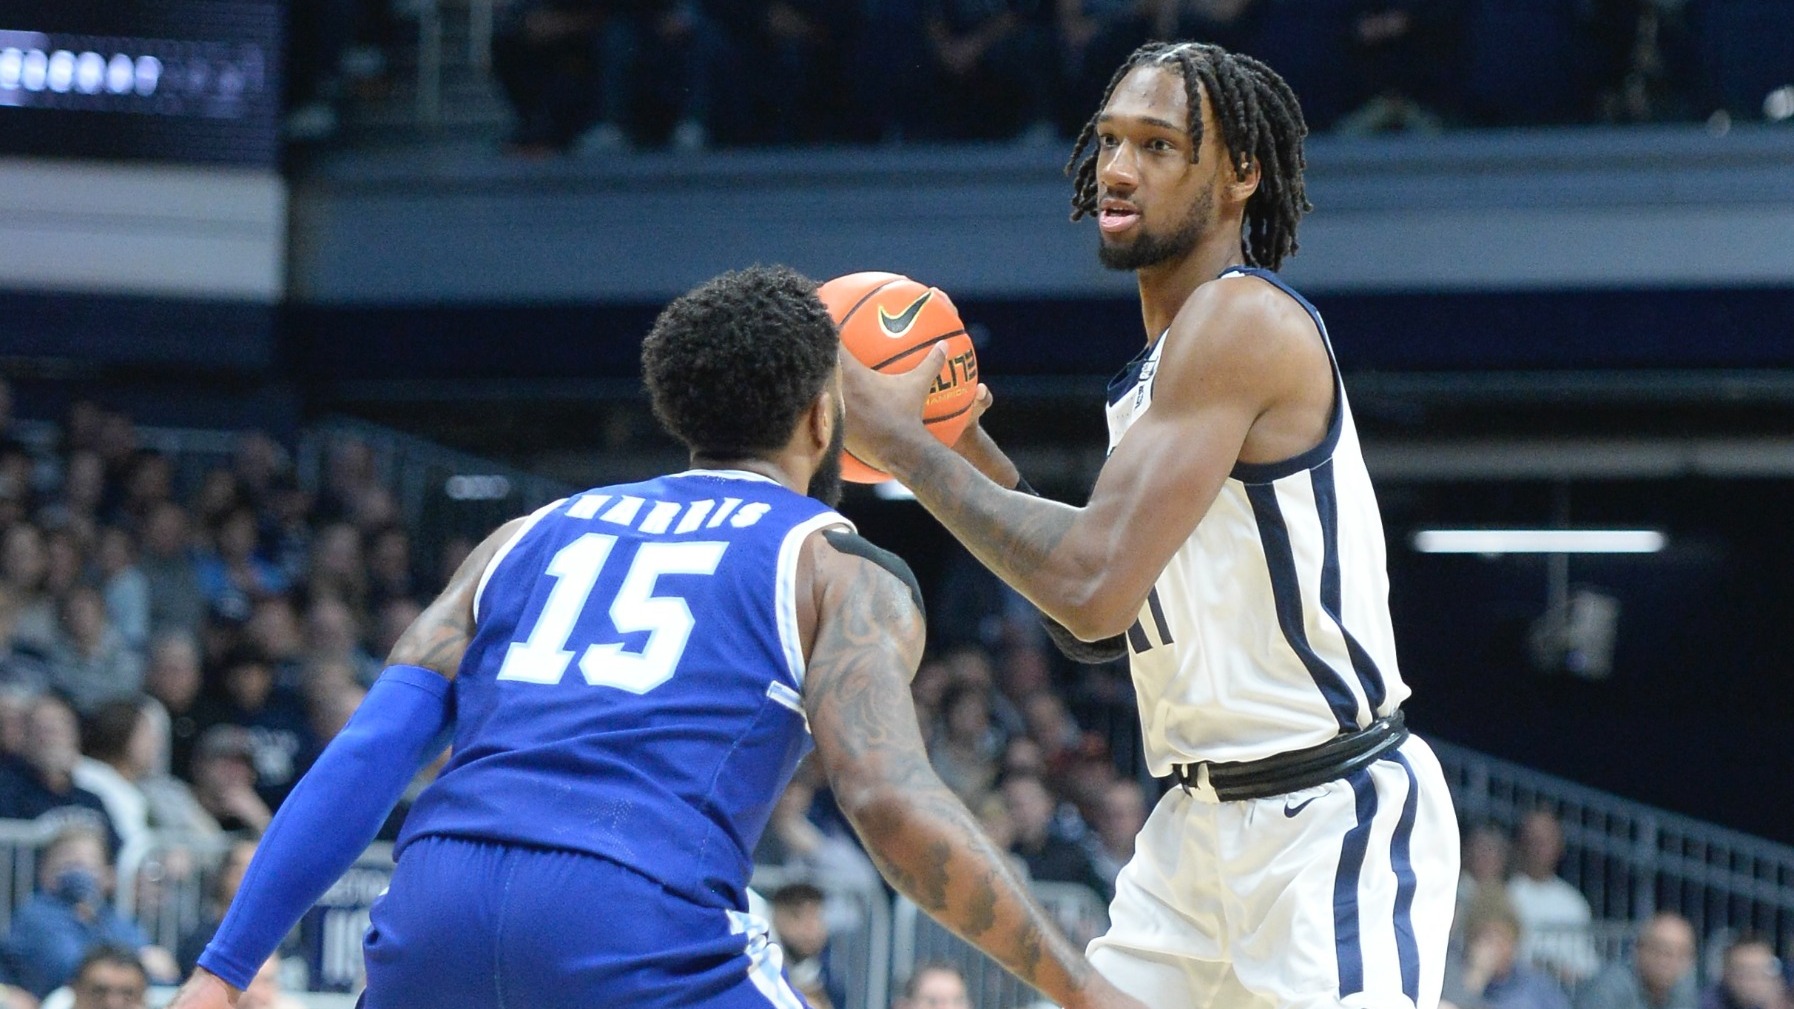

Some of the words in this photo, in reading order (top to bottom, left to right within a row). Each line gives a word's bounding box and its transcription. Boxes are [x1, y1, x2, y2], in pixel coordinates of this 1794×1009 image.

[929, 348, 978, 395] LITE
[564, 494, 772, 535] HARRIS
[496, 531, 731, 696] 15
